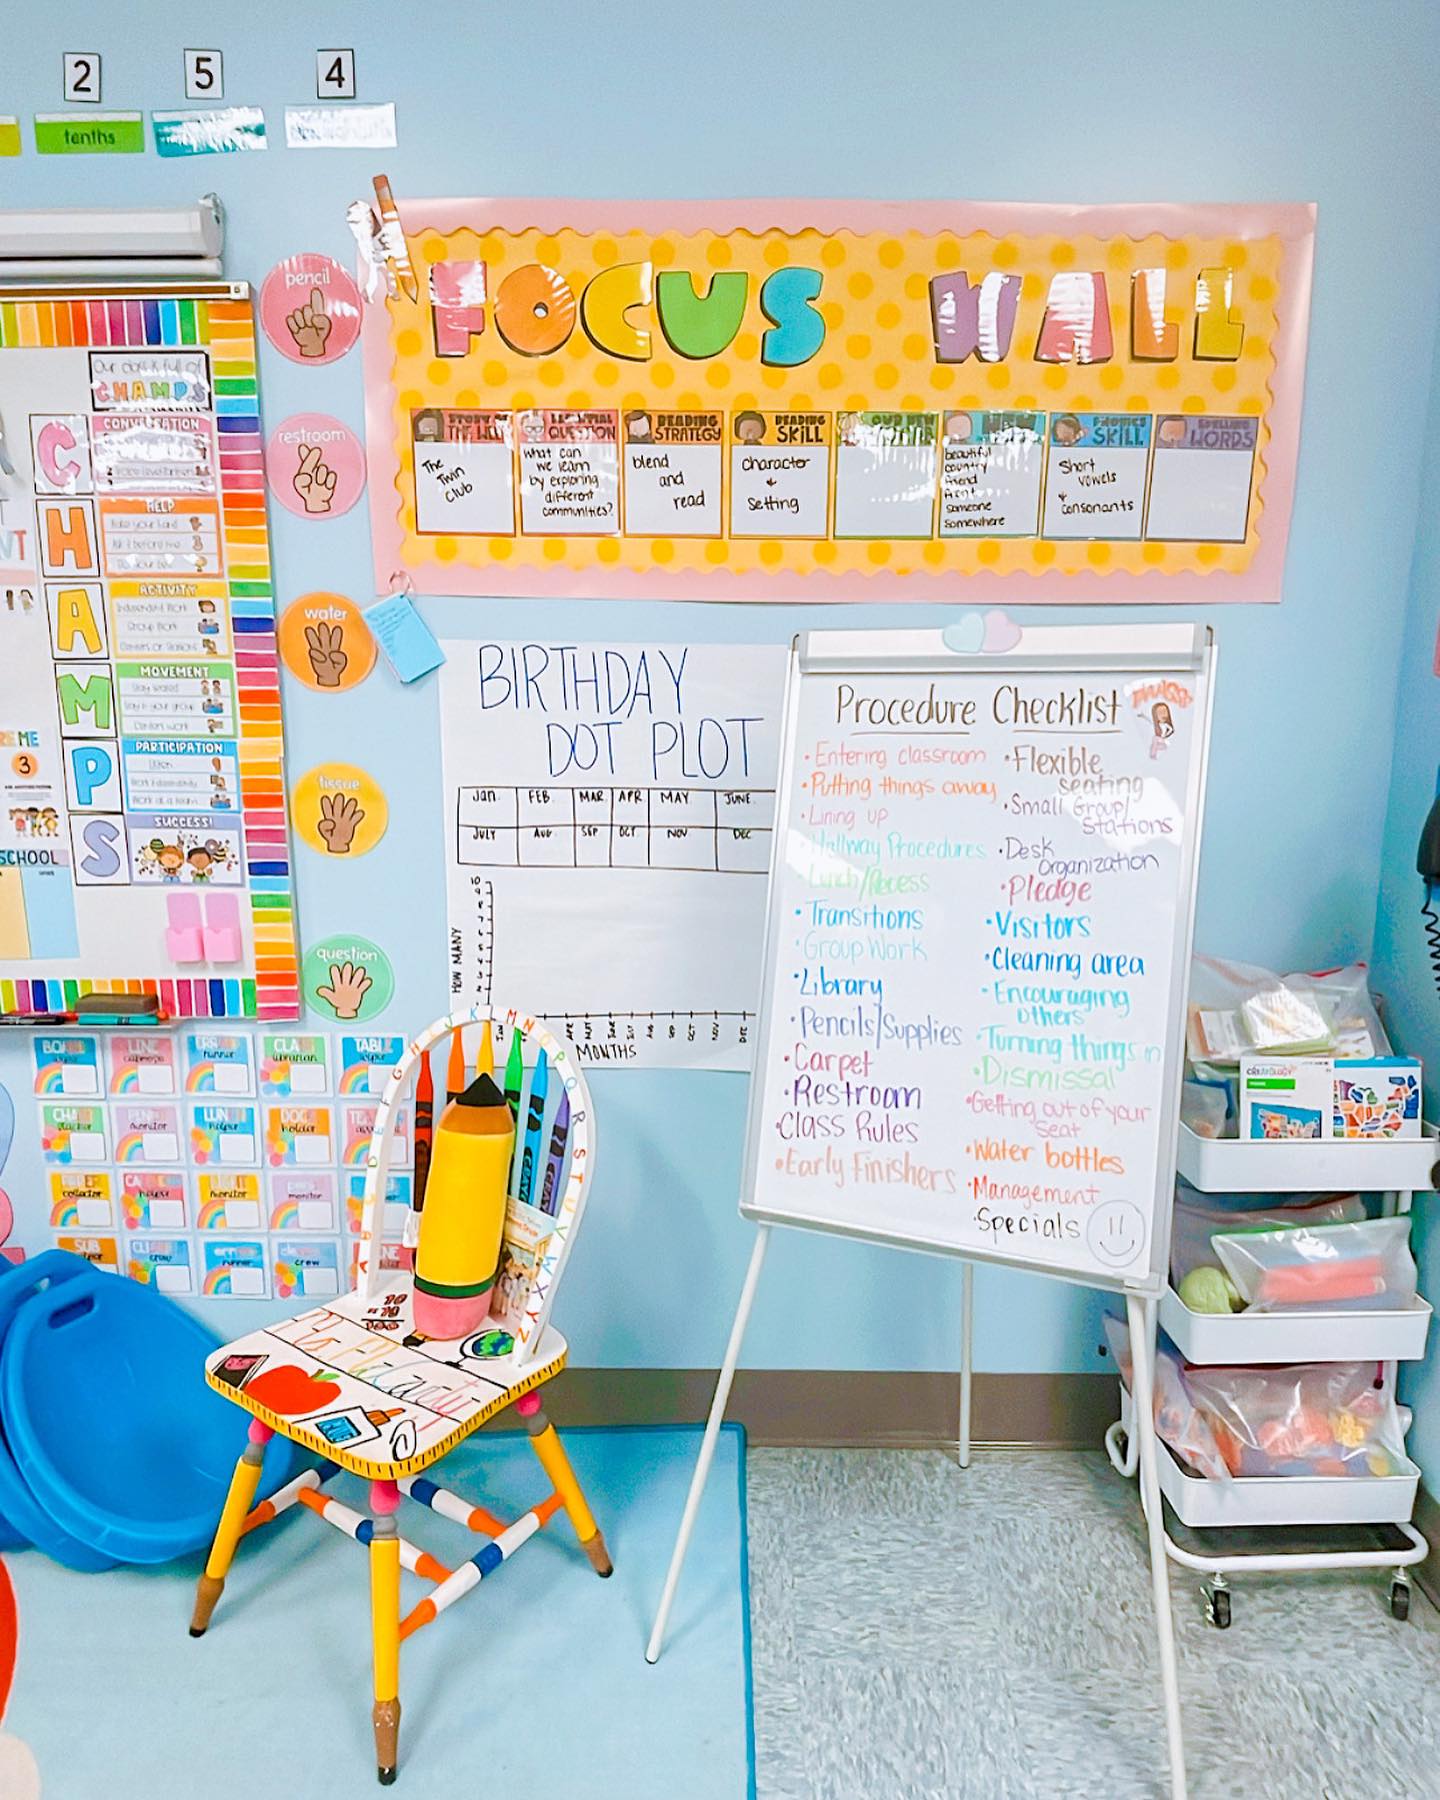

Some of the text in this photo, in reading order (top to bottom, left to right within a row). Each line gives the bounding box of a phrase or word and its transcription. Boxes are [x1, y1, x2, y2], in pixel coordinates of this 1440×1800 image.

[73, 59, 92, 93] 2
[194, 56, 214, 90] 5
[324, 56, 346, 89] 4
[64, 127, 116, 146] tenths
[285, 271, 330, 288] pencil
[429, 260, 1245, 367] FOCUS WALL
[95, 381, 206, 402] CHAMPS
[279, 428, 345, 443] restroom
[655, 427, 721, 441] STRATEGY
[1190, 430, 1254, 448] WORDS
[38, 421, 81, 487] C
[422, 458, 444, 474] The
[537, 460, 590, 472] we learn
[560, 448, 581, 459] can
[633, 454, 669, 470] blend
[742, 456, 810, 471] character
[945, 447, 992, 461] beautiful
[436, 466, 465, 487] Twin
[659, 471, 684, 487] and
[945, 462, 988, 474] country
[1078, 471, 1117, 487] vowels
[445, 482, 473, 503] Club
[530, 474, 599, 490] by exploring
[146, 500, 175, 513] HELP
[542, 502, 614, 517] communities?
[545, 490, 594, 504] different
[674, 490, 705, 510] read
[1061, 500, 1134, 515] consonants
[46, 507, 92, 569] H
[57, 588, 103, 654] A
[304, 606, 347, 620] water
[141, 666, 209, 678] MOVEMENT
[479, 643, 688, 718] BIRTHDAY
[56, 673, 110, 730] M
[837, 683, 976, 725] Procedure
[993, 685, 1123, 726] Checklist
[18, 731, 39, 747] ME
[135, 742, 223, 753] PARTICIPATION
[546, 717, 765, 780] DOT PLOT
[18, 756, 31, 774] 3
[815, 740, 986, 769] Entering classroom
[1013, 744, 1103, 775] Flexible
[72, 746, 112, 805] P
[318, 775, 360, 790] tissue
[811, 771, 997, 803] Putting things away
[1058, 774, 1144, 801] seating
[660, 792, 689, 804] MAY
[1011, 792, 1063, 816] Small
[153, 816, 213, 827] SUCCESS!
[809, 804, 888, 831] Lining up
[473, 827, 496, 840] JULY
[0, 850, 59, 865] SCHOOL
[80, 819, 120, 877] S
[811, 830, 987, 865] Hallway Procedures
[1006, 837, 1054, 860] Desk
[471, 876, 481, 885] 10
[1009, 874, 1092, 907] Pledge
[805, 899, 924, 930] Transitions
[995, 911, 1091, 940] Visitors
[316, 946, 378, 962] question
[451, 927, 462, 965] MANY
[804, 930, 928, 965] Group Work
[992, 947, 1145, 980] Cleaning area
[800, 966, 883, 1003] Library
[994, 980, 1131, 1018] Encouraging
[801, 1003, 963, 1050] Pencils/Supplies
[575, 1043, 637, 1061] MONTHS
[980, 1024, 1161, 1072] Turning things in
[795, 1042, 873, 1081] Carpet
[982, 1054, 1116, 1090] Dismissal
[794, 1074, 922, 1109] Restroom
[972, 1091, 1152, 1125] Getting out of your
[779, 1111, 919, 1143] Class Rules
[974, 1137, 1125, 1175] Water bottles
[785, 1145, 956, 1194] Early Finishers
[973, 1175, 1101, 1209] Management
[976, 1206, 1080, 1244] Specials
